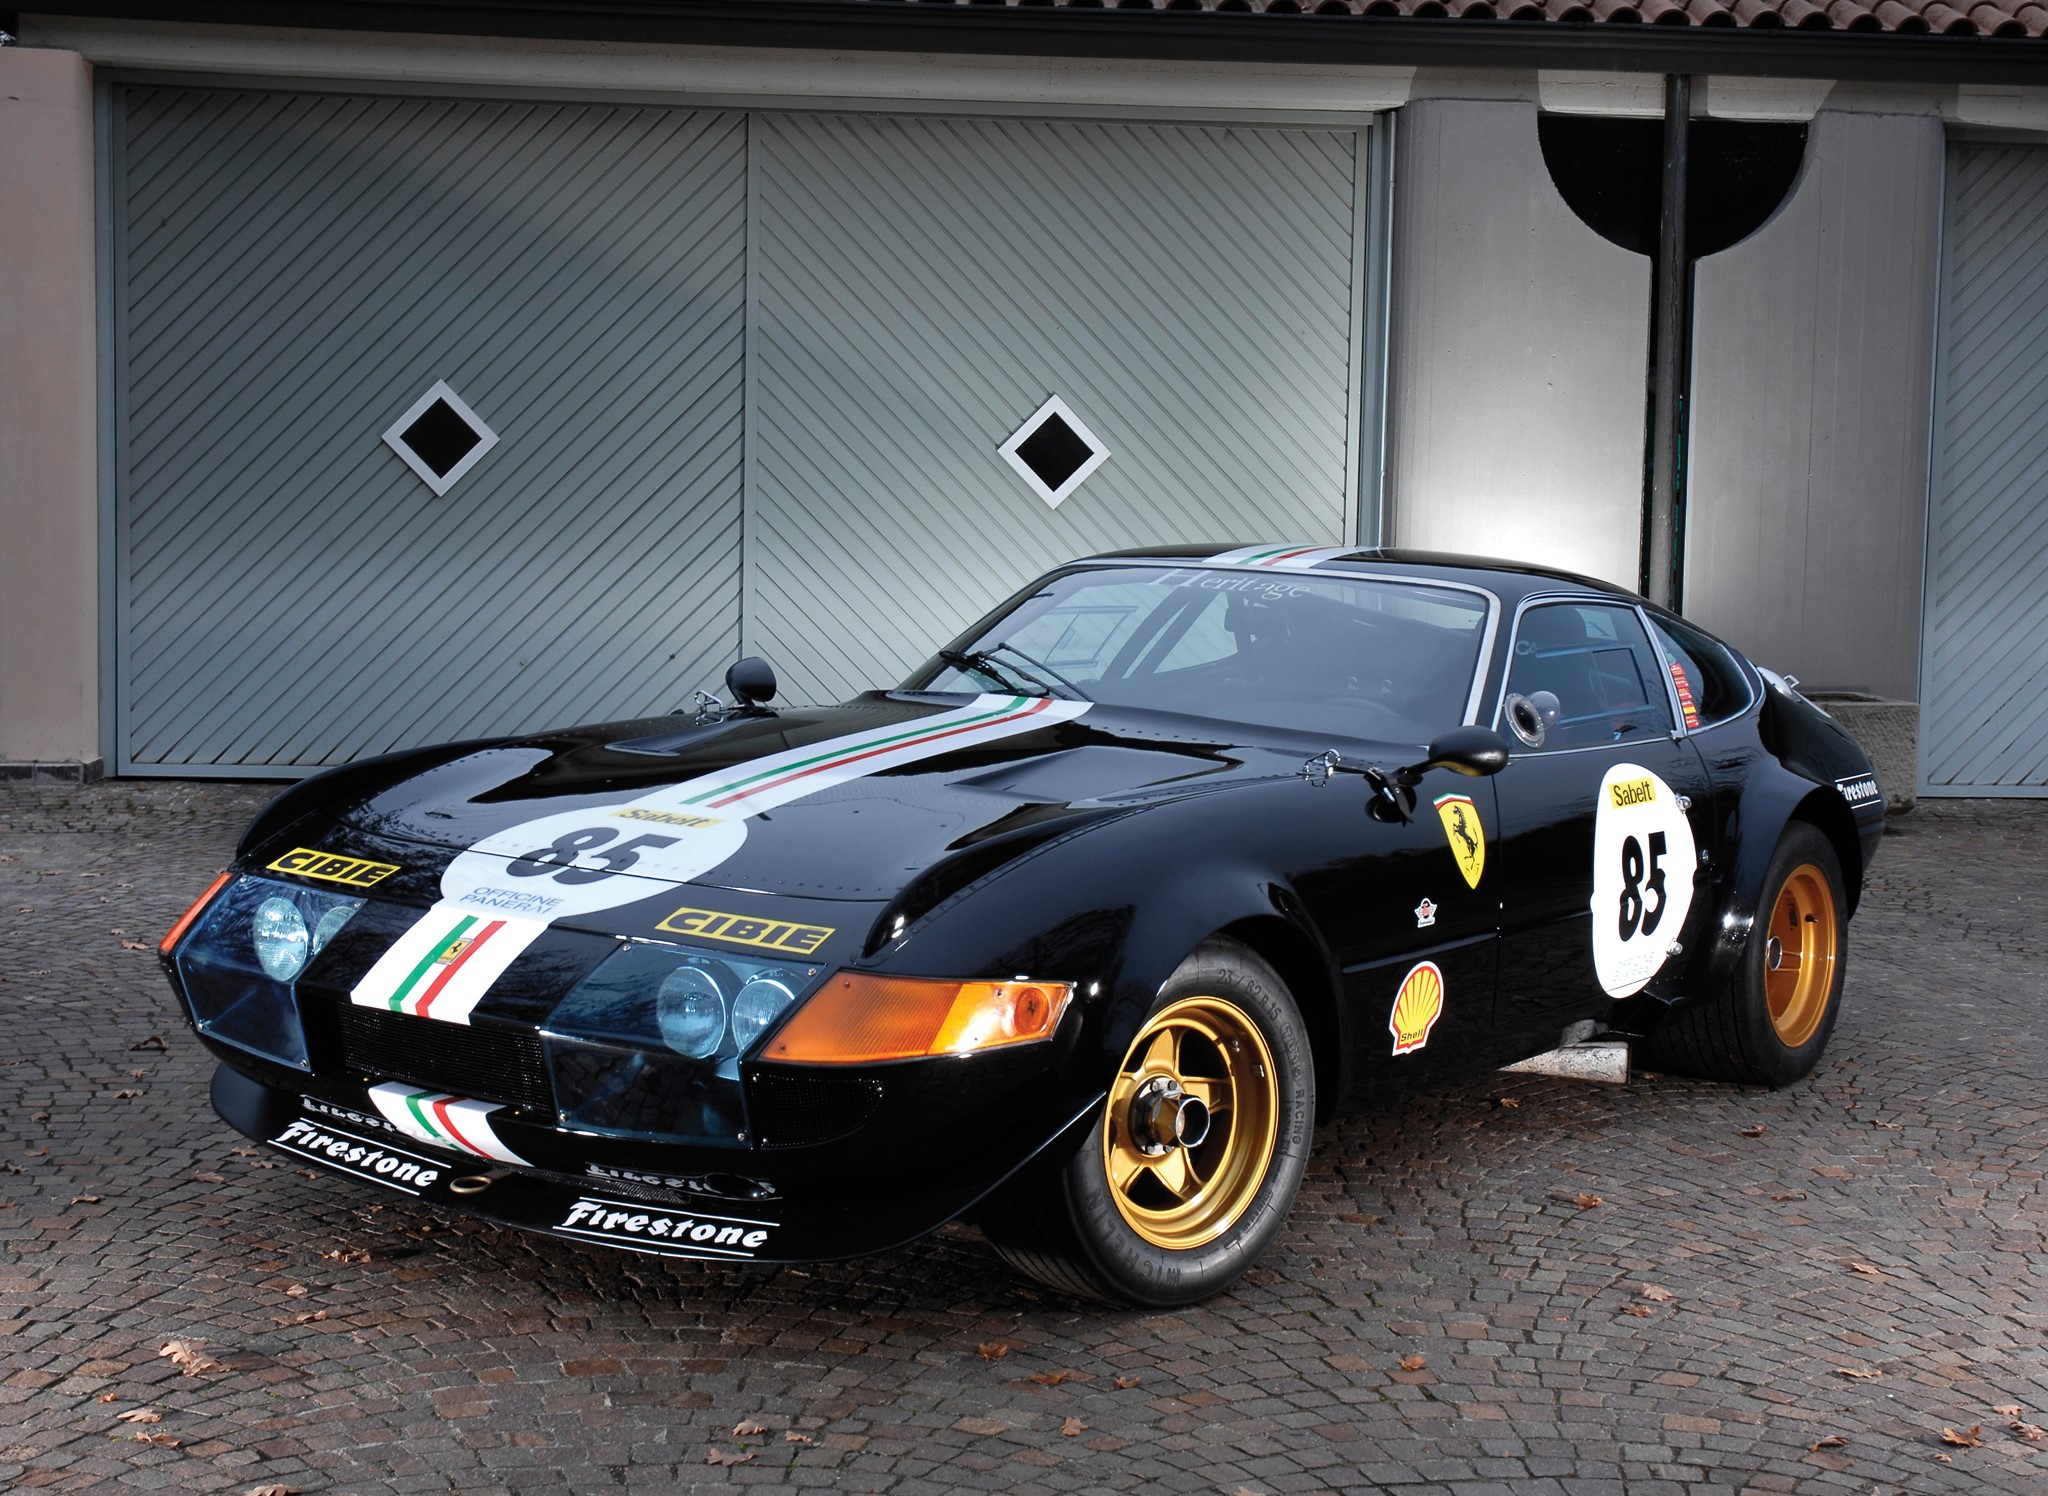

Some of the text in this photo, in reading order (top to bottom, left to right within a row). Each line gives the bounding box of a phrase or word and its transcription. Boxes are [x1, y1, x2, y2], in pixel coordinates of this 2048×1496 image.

[1149, 569, 1311, 600] Heritage
[1613, 780, 1653, 806] Sabelt
[619, 809, 709, 827] Sabelt
[506, 827, 682, 885] 85
[460, 894, 552, 914] PANERAI
[473, 886, 565, 907] OFFICINE
[1618, 830, 1668, 942] 85
[1400, 1029, 1423, 1042] Shell
[1292, 1089, 1305, 1145] RACING
[276, 1121, 439, 1187] Firestone
[561, 1201, 768, 1248] Firestone
[1085, 1188, 1182, 1287] MICHELIN
